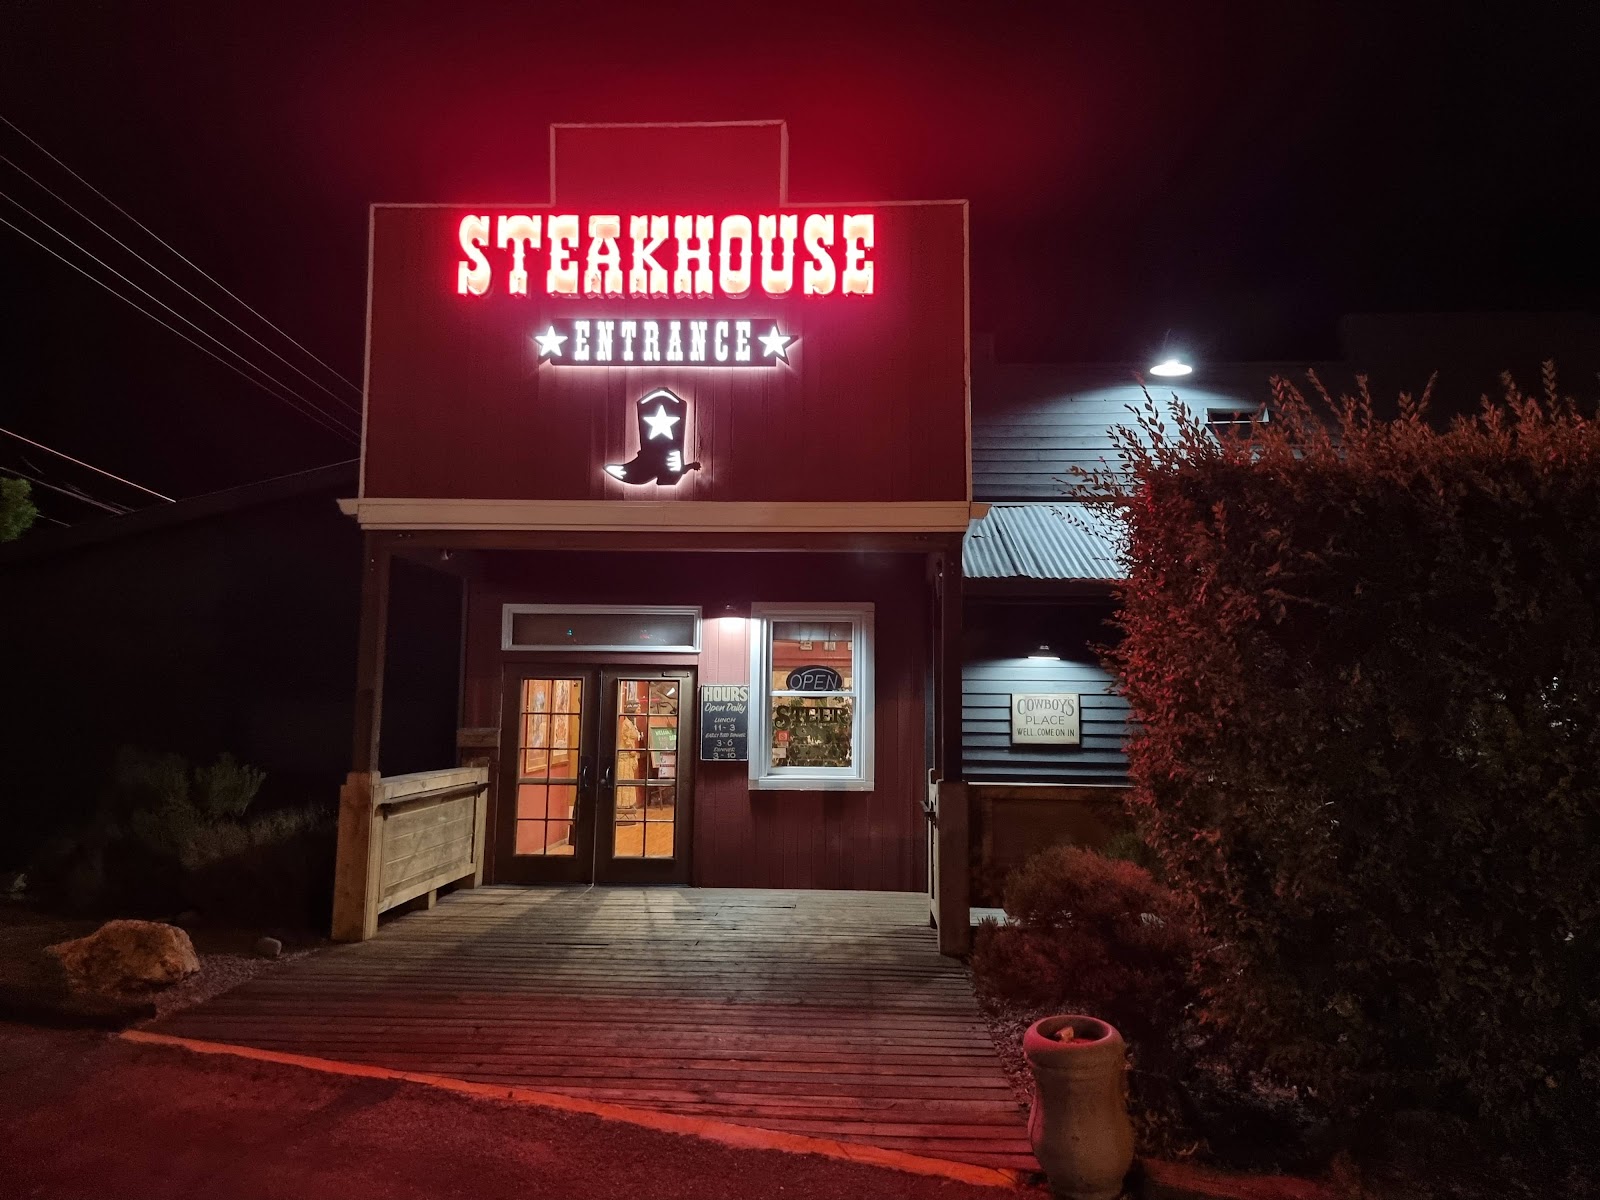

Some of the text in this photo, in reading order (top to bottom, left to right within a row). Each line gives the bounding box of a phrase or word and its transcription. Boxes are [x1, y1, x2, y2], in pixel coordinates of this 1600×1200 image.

[457, 213, 875, 297] STEAKHOUSE
[574, 320, 752, 362] ENTRANCE
[790, 674, 838, 690] OPEN
[703, 687, 748, 701] HOURS
[705, 703, 746, 714] Open Daily
[1016, 697, 1075, 717] COWBOY'S
[1025, 715, 1065, 725] PLACE
[1055, 728, 1066, 737] ON
[1067, 728, 1075, 737] IN
